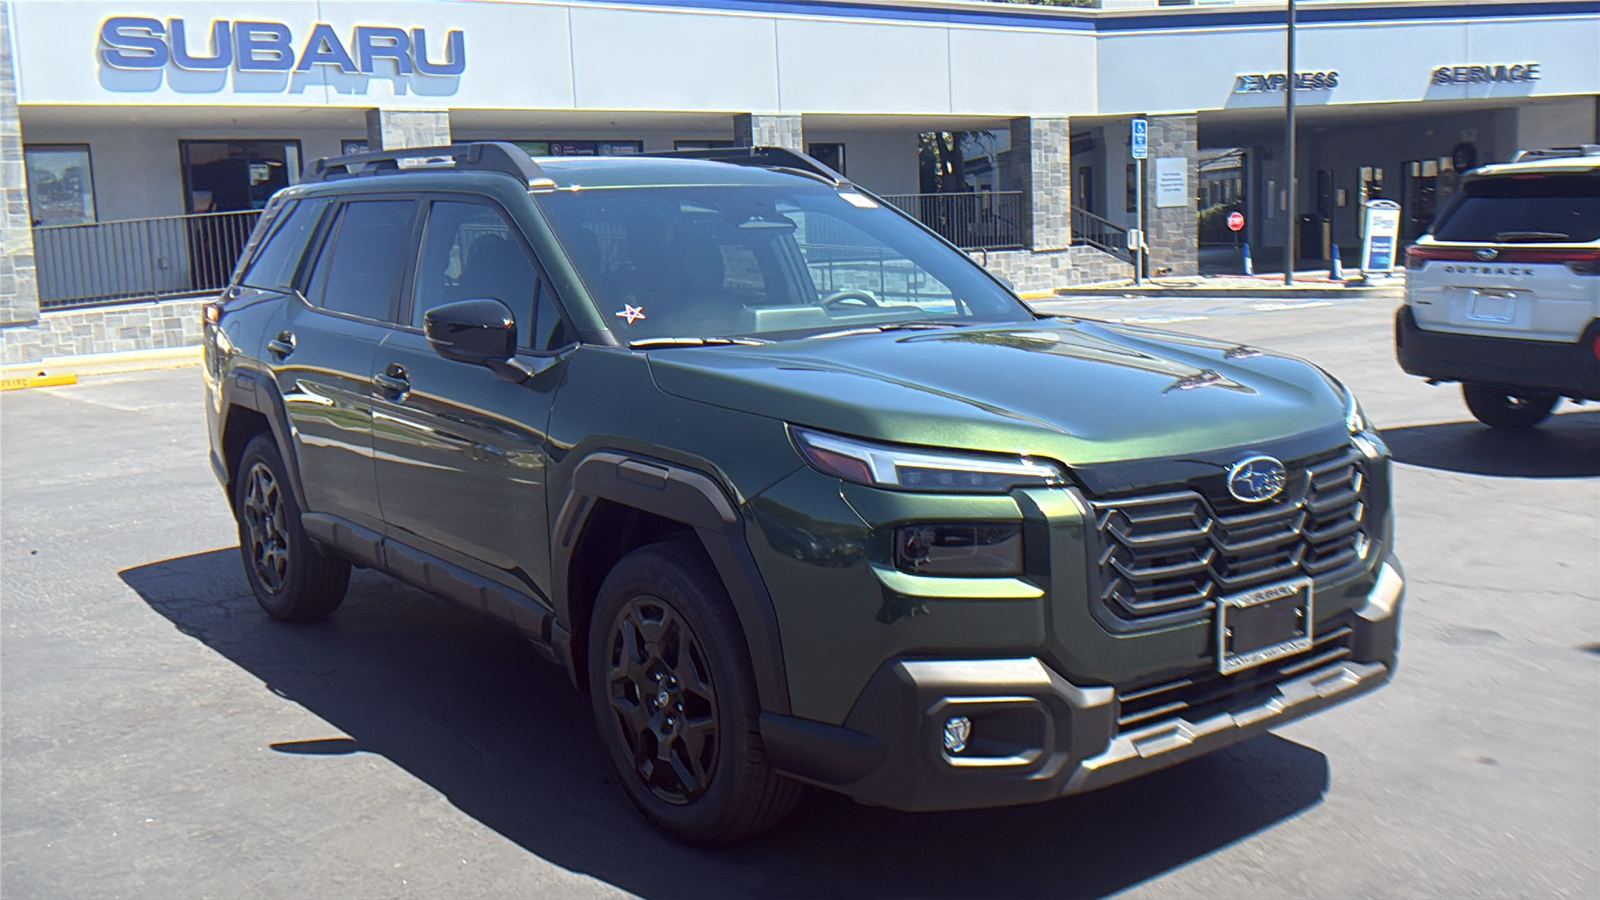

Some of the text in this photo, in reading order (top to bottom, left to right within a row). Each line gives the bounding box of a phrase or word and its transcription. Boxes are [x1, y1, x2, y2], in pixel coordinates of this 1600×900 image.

[100, 16, 465, 76] SUBARU
[1432, 63, 1541, 84] SERVICE
[1444, 265, 1533, 276] OUTBACK
